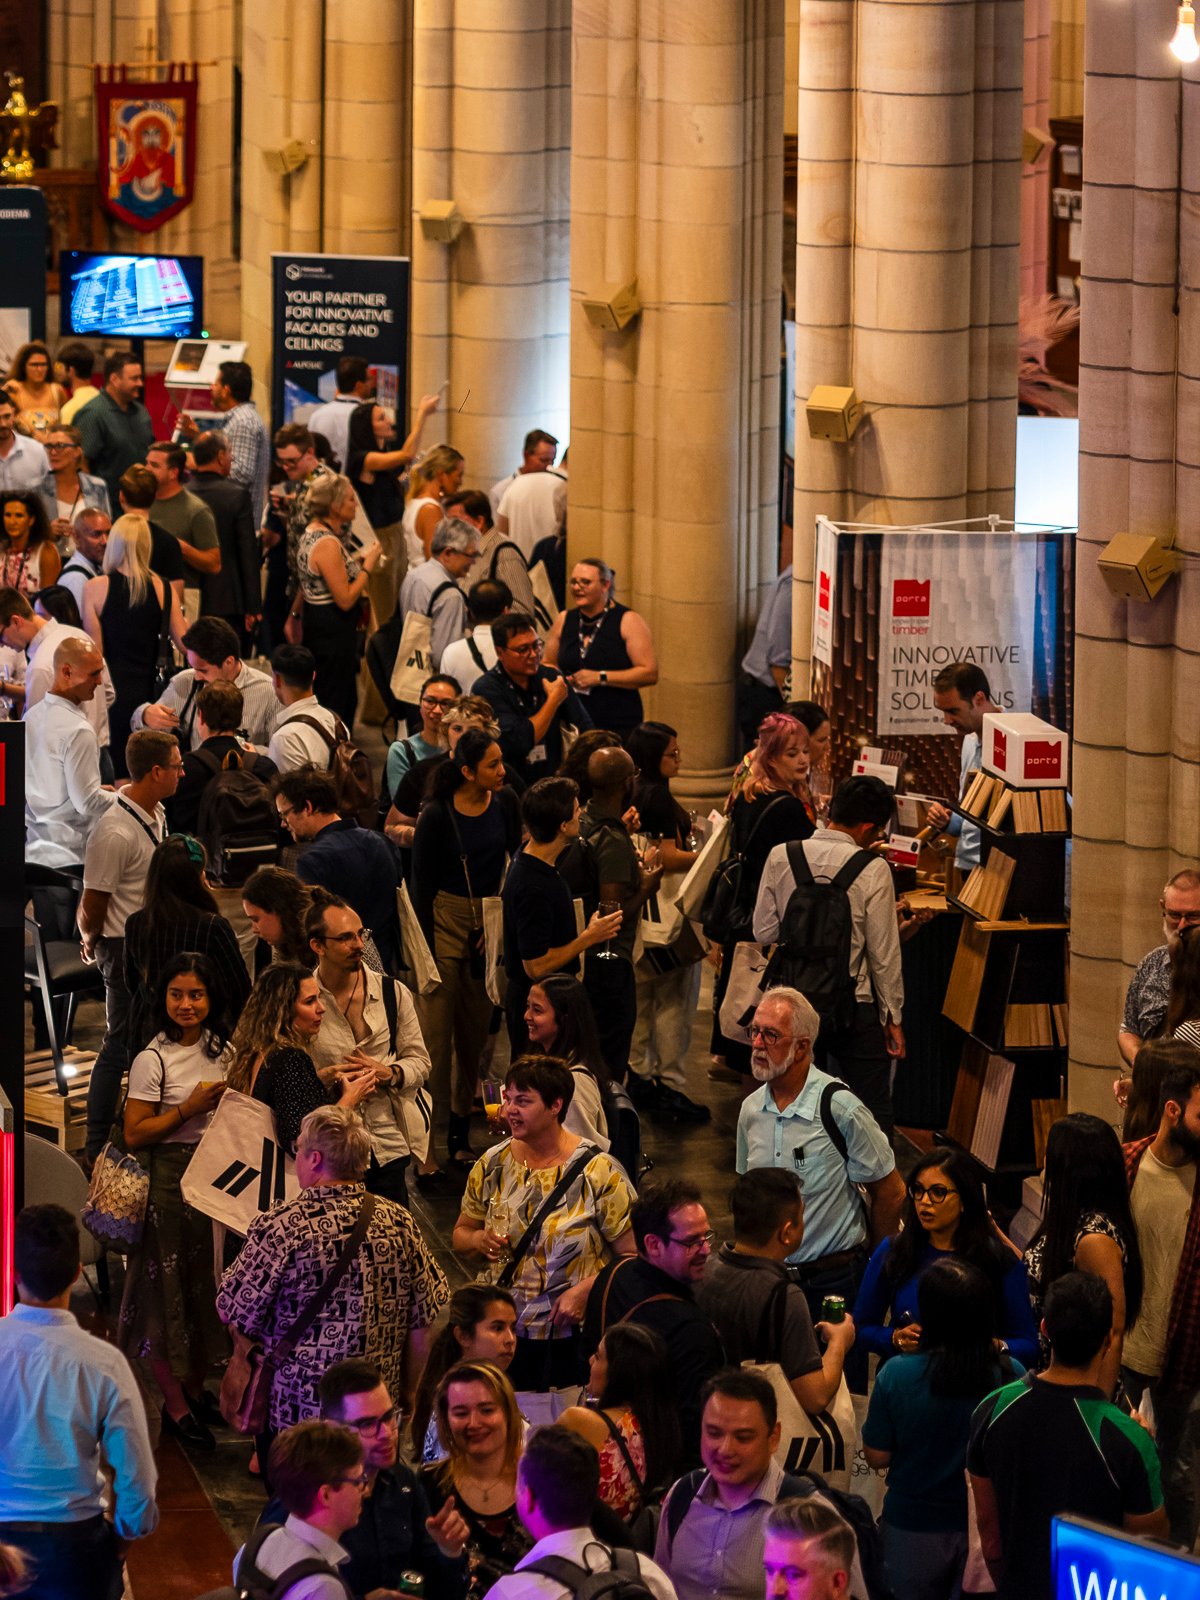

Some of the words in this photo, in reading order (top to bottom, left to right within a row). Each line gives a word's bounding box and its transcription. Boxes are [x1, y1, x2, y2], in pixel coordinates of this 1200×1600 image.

[285, 290, 324, 304] YOUR
[325, 291, 388, 306] PARTNER
[285, 305, 313, 319] FOR
[315, 307, 394, 323] INNOVATIVE
[285, 321, 347, 336] FACADES
[348, 323, 379, 338] AND
[285, 336, 344, 352] CEILINGS
[895, 595, 927, 603] porta
[892, 625, 929, 635] timber
[893, 646, 1020, 664] INNOVATIVE
[891, 669, 942, 687] TIMB
[891, 690, 1015, 710] SOLNS
[1026, 757, 1059, 765] porta
